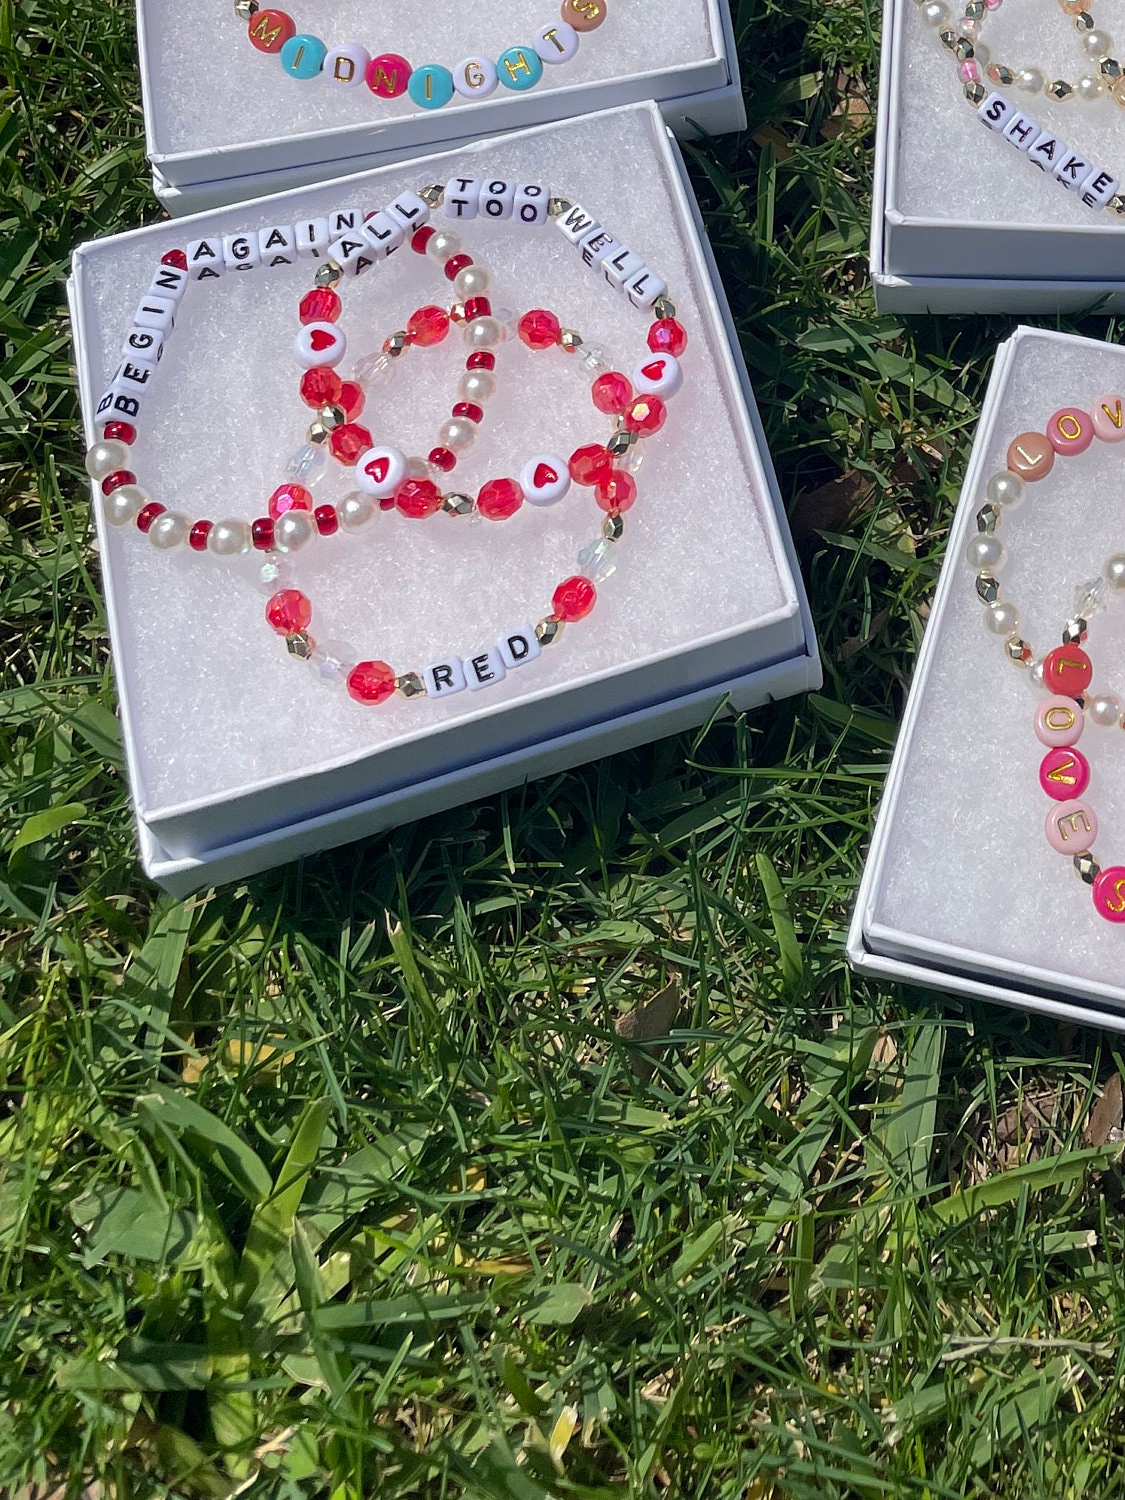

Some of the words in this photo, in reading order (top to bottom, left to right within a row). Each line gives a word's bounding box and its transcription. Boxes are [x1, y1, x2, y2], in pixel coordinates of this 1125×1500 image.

[985, 100, 1116, 199] SHAKE
[340, 200, 423, 260] ALL
[450, 178, 546, 222] TOO
[563, 206, 652, 298] WELL
[112, 269, 183, 416] BEGIN
[192, 210, 357, 262] AGAIN
[432, 634, 533, 689] RED
[1042, 658, 1095, 843] LOVE
